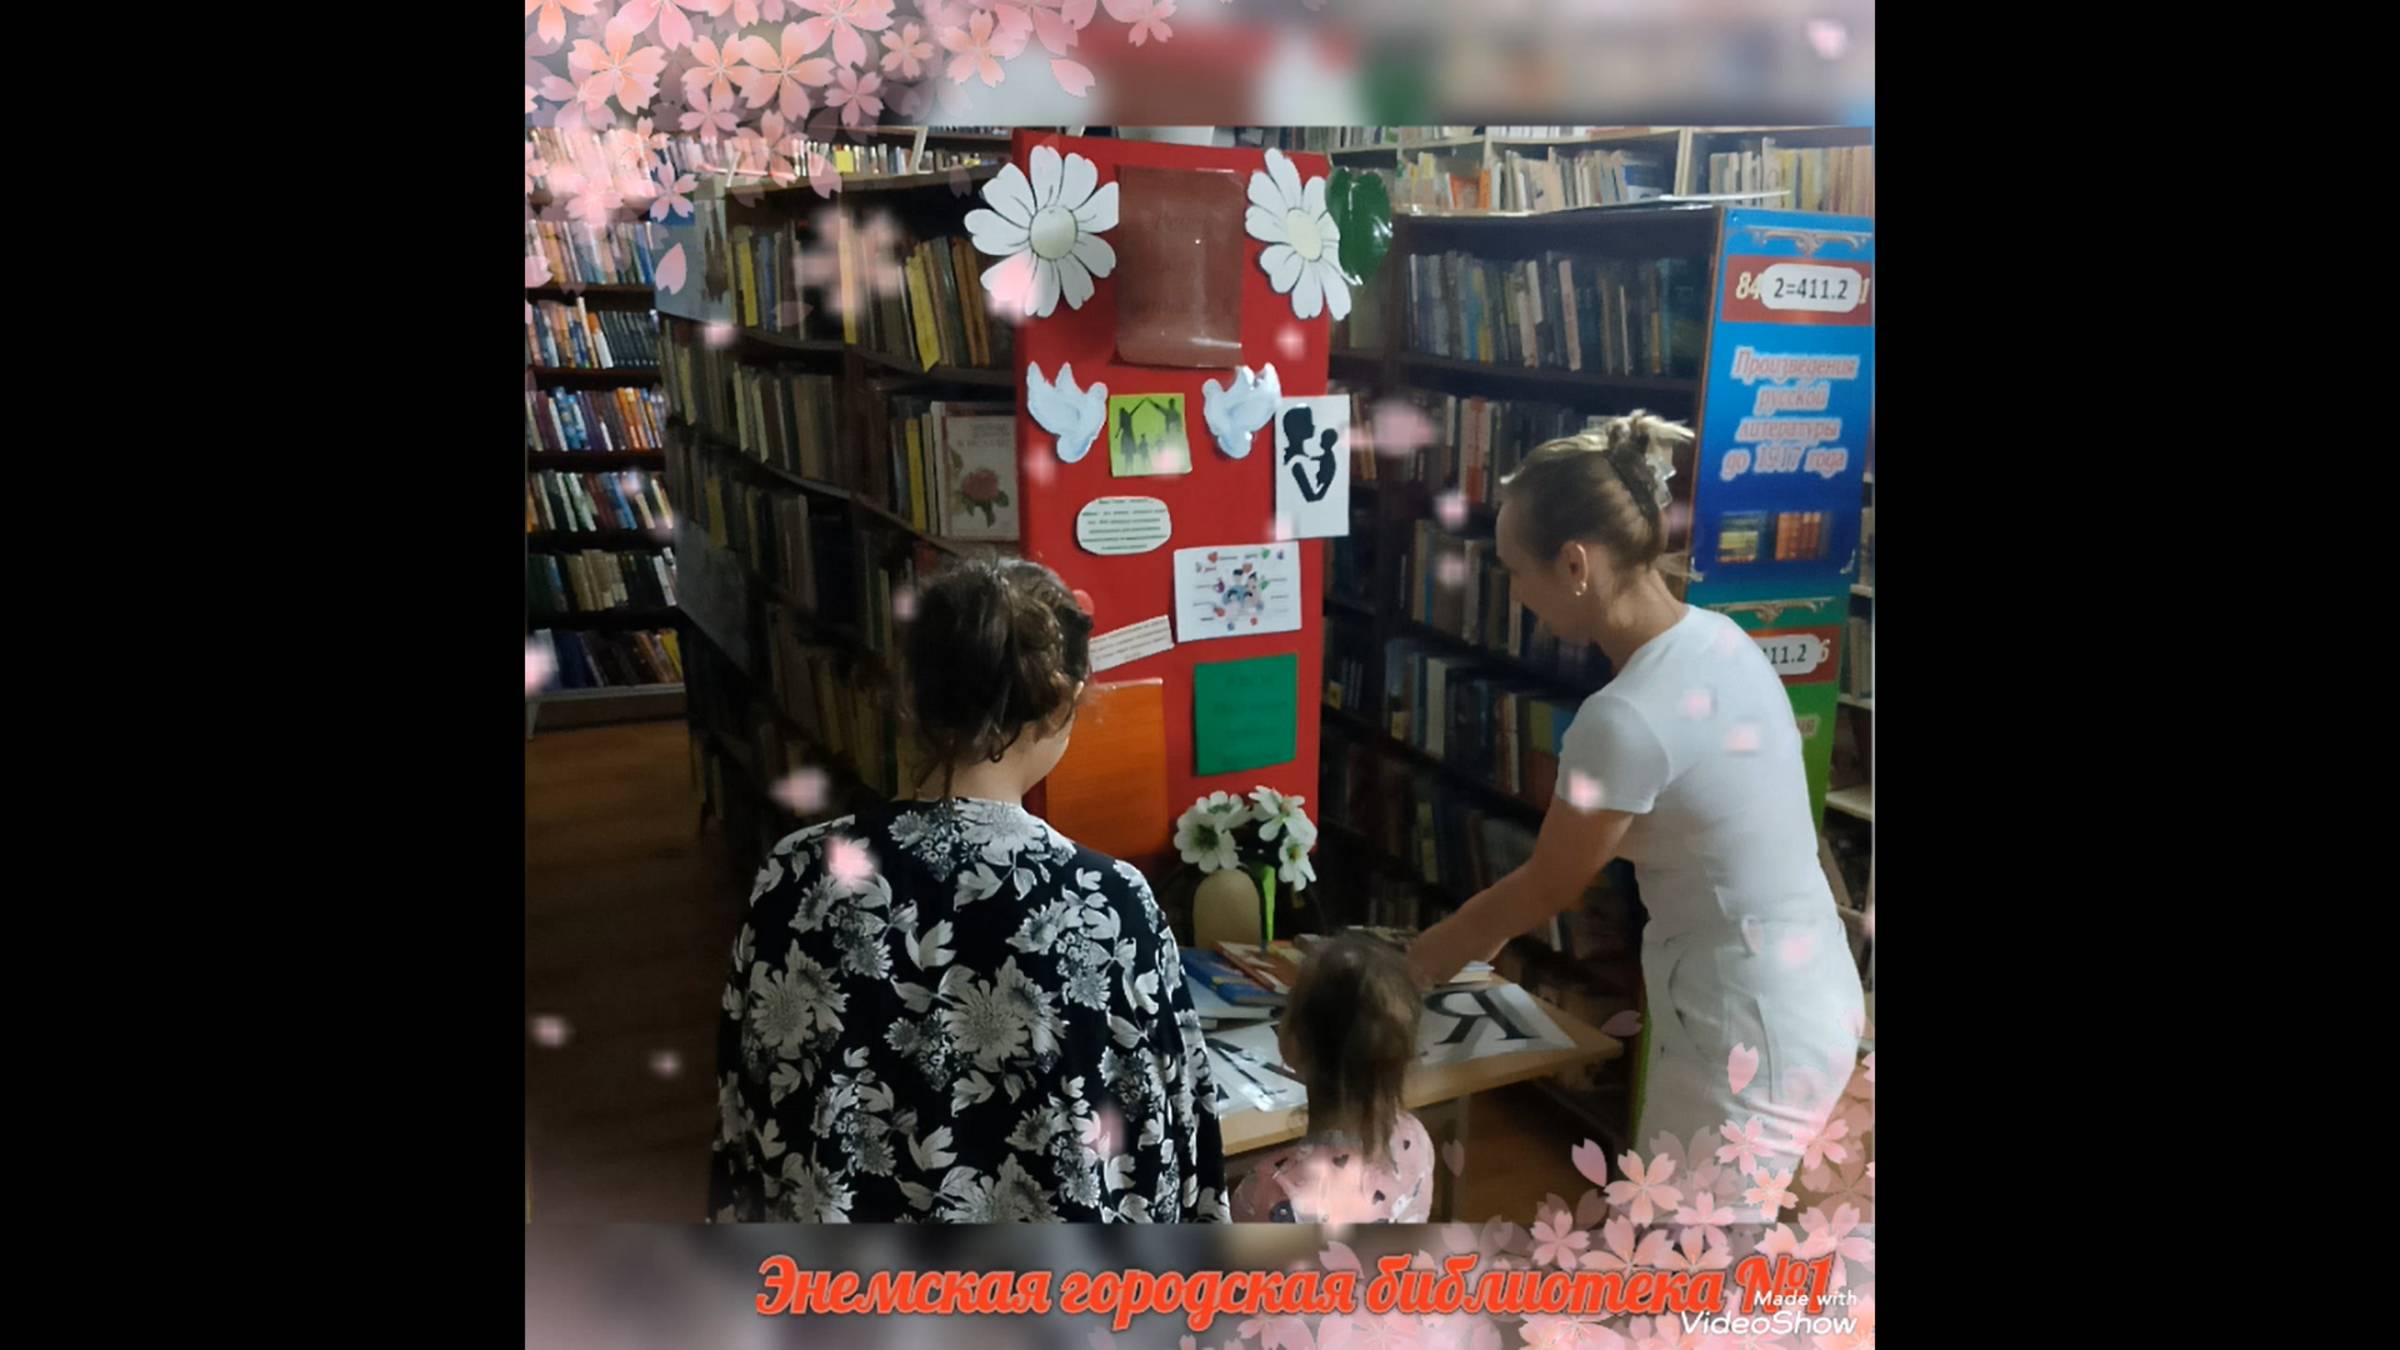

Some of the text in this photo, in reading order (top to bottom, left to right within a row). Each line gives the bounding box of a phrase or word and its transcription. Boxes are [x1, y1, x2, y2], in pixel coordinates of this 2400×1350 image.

[1774, 278, 1848, 300] 2=411.2
[1732, 347, 1859, 384] Произведения
[1754, 381, 1829, 415] русской
[1736, 417, 1841, 446] литературы
[1721, 450, 1750, 480] до
[1804, 449, 1847, 478] года
[1763, 644, 1806, 664] 11.2
